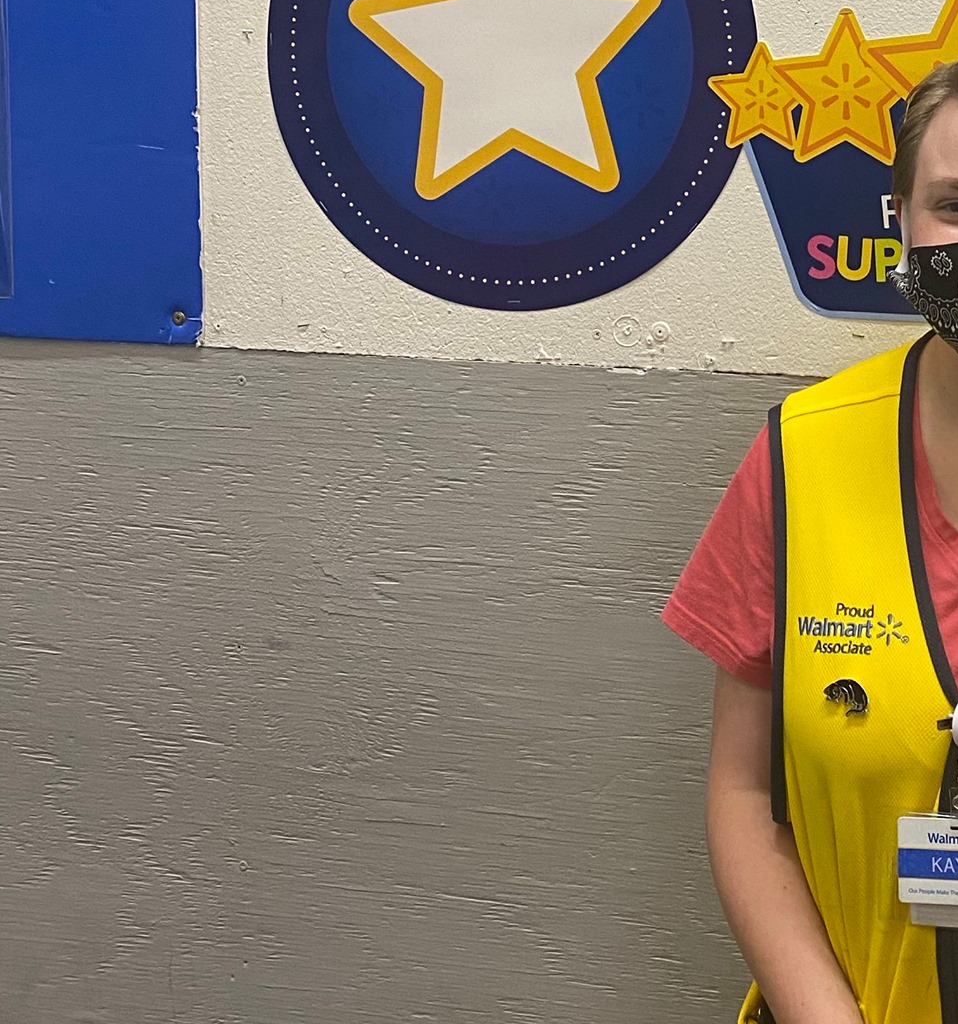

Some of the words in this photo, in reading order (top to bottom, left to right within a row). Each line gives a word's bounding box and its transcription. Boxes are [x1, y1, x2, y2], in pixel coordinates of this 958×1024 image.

[836, 602, 874, 618] Proud
[798, 616, 873, 638] Walmart
[814, 640, 872, 655] Associate
